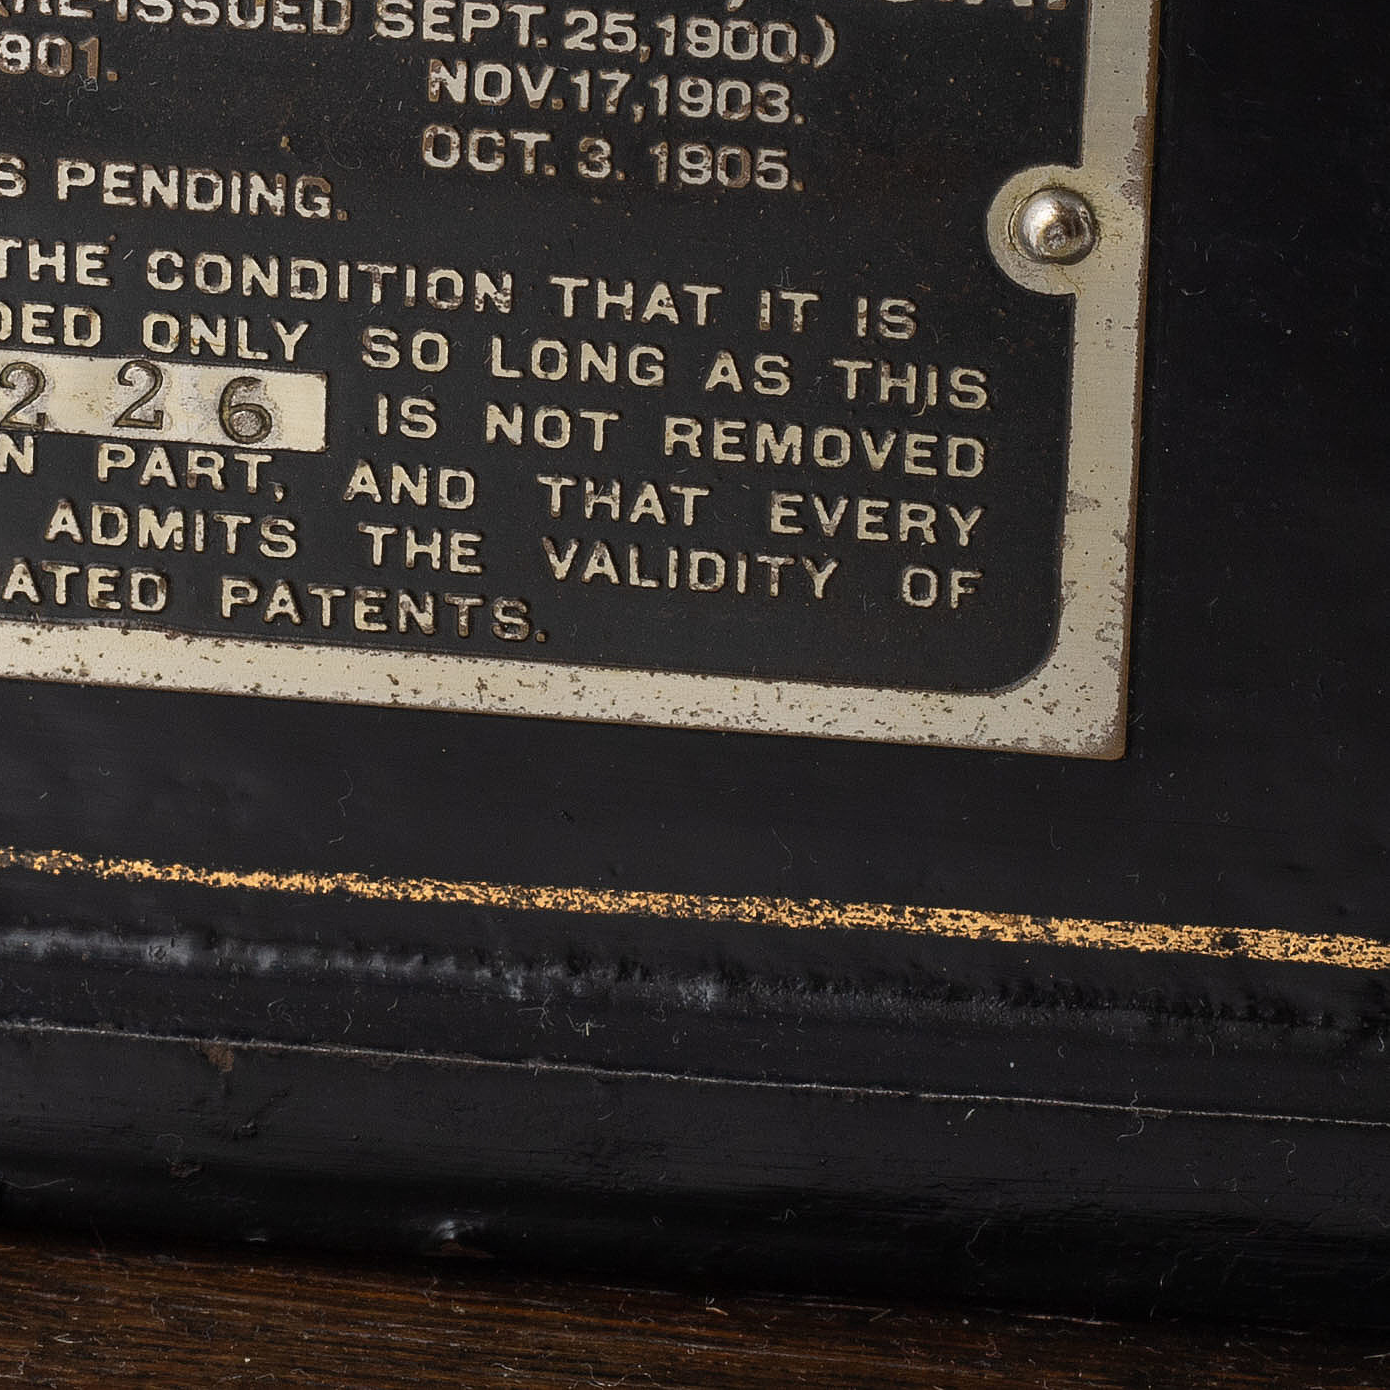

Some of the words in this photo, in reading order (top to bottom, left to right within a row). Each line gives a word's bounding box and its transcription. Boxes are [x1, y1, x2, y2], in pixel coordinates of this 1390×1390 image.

[56, 157, 348, 221] PENDING.
[421, 123, 556, 176] OCT.
[649, 141, 803, 191] 1905.
[146, 248, 513, 314] CONDITION
[549, 275, 723, 327] THAT
[758, 289, 820, 333] IT
[856, 297, 916, 340] IS
[142, 310, 309, 362] ONLY
[361, 325, 450, 373] SO
[490, 335, 665, 387] LONG
[704, 350, 791, 397] AS
[832, 358, 988, 416] THIS
[377, 393, 438, 439] IS
[485, 402, 620, 452] NOT
[664, 415, 985, 478] REMOVED
[96, 439, 284, 502] PART,
[342, 459, 476, 510] AND
[536, 473, 710, 527] THAT
[770, 490, 983, 547] EVERY
[44, 498, 297, 559] ADMITS
[357, 521, 482, 574] THE
[542, 536, 838, 599] VALIDITY
[901, 565, 982, 609] OF
[220, 575, 545, 642] PATENTS.
